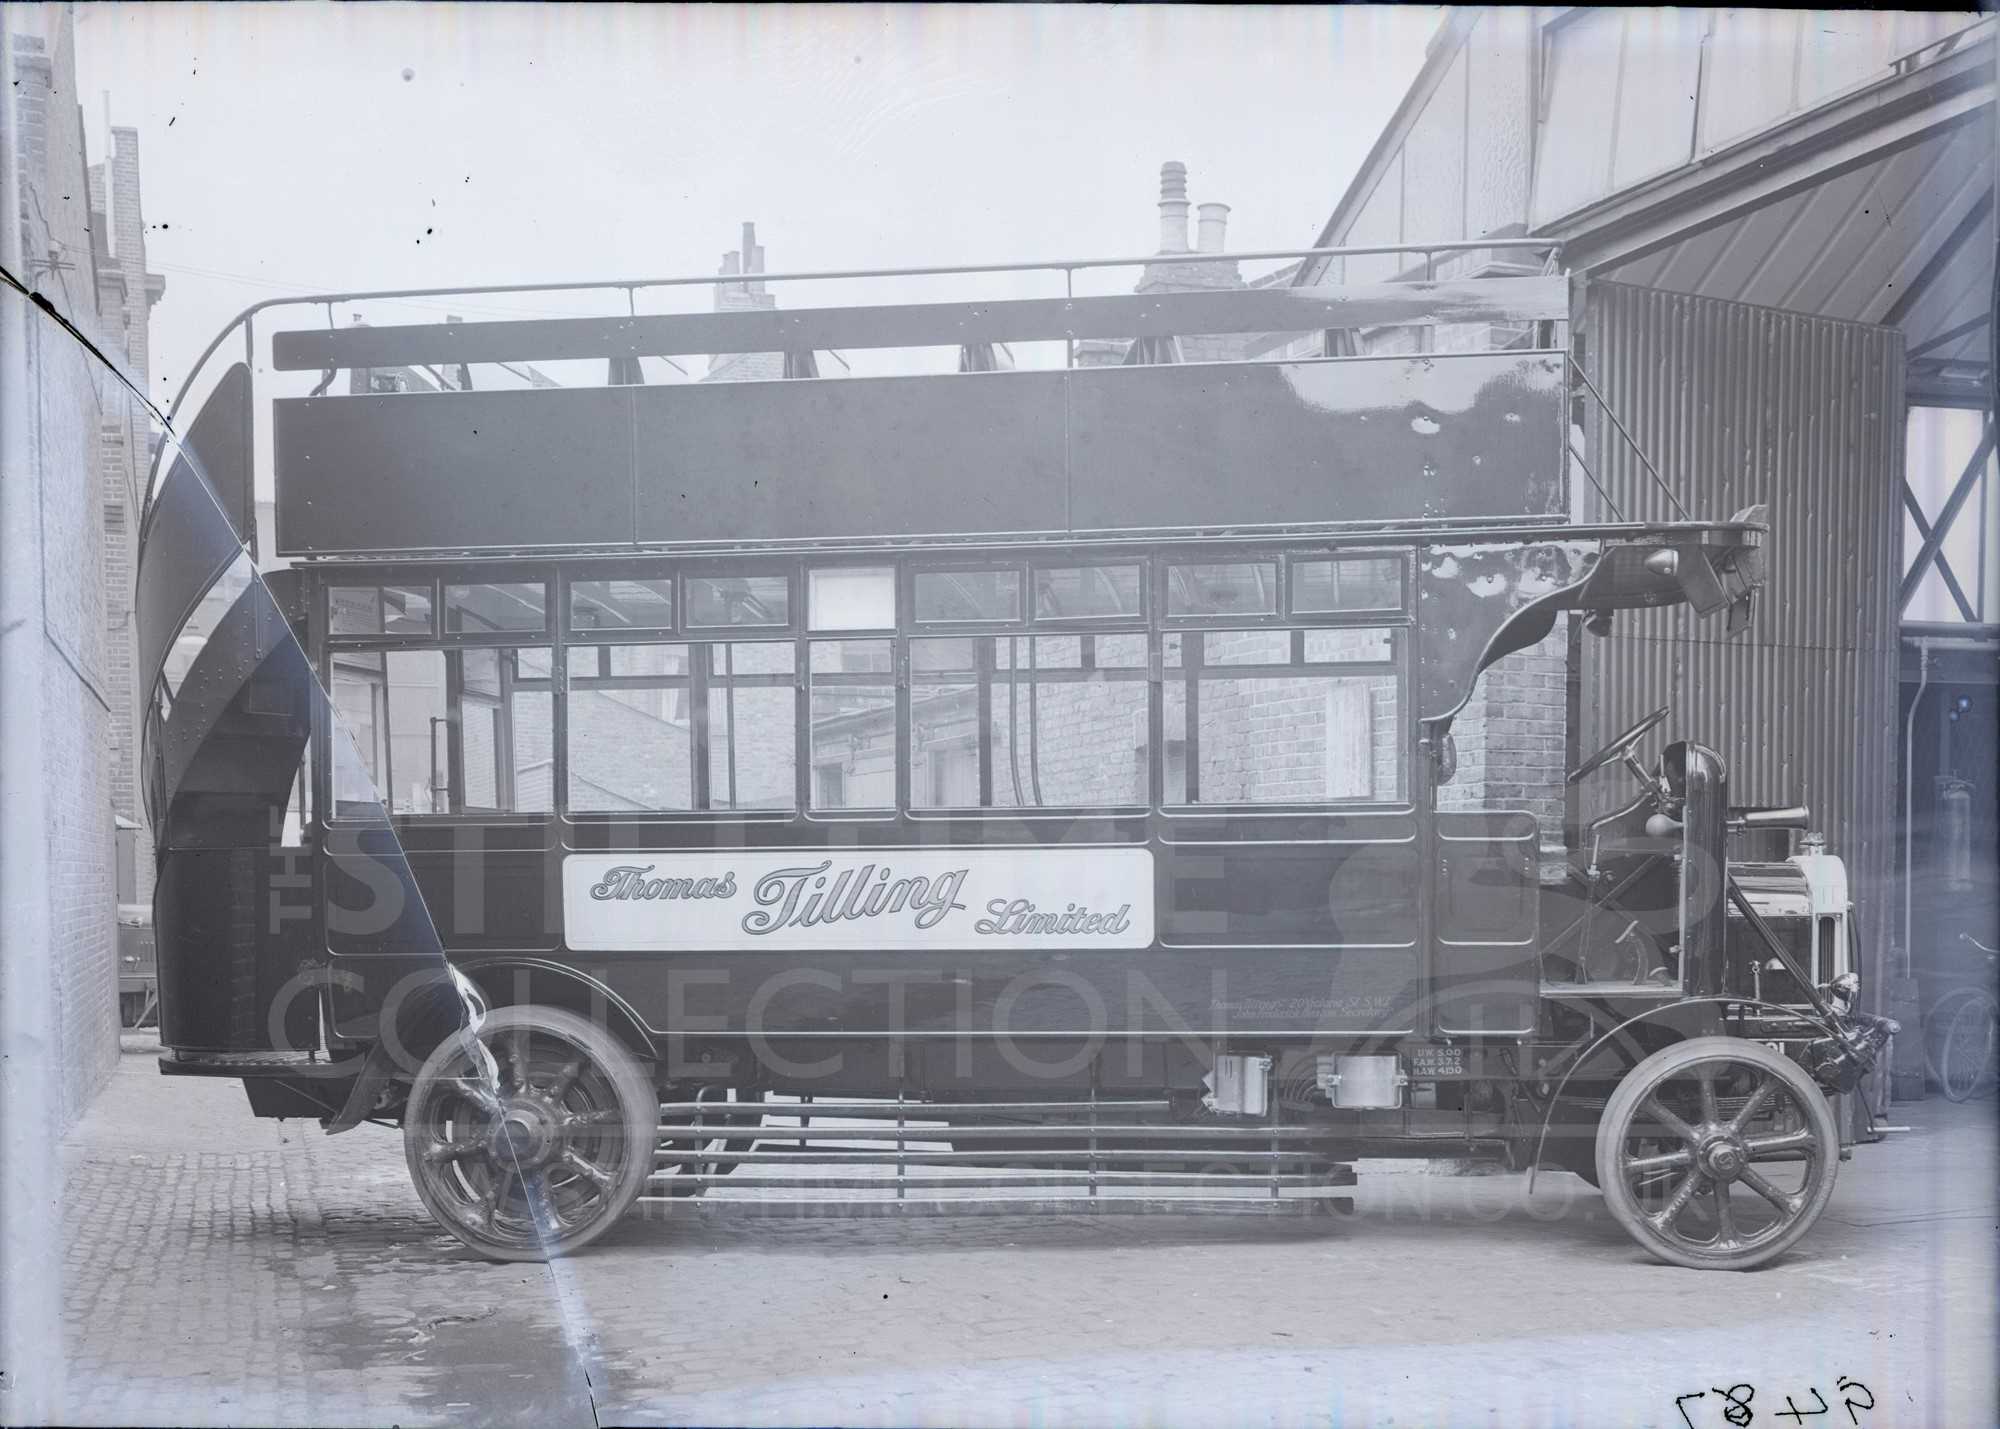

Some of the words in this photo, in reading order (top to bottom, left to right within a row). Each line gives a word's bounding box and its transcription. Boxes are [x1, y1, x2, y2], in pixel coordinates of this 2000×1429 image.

[589, 864, 738, 901] Thomas
[741, 860, 969, 936] Tilling
[974, 898, 1131, 935] Limited
